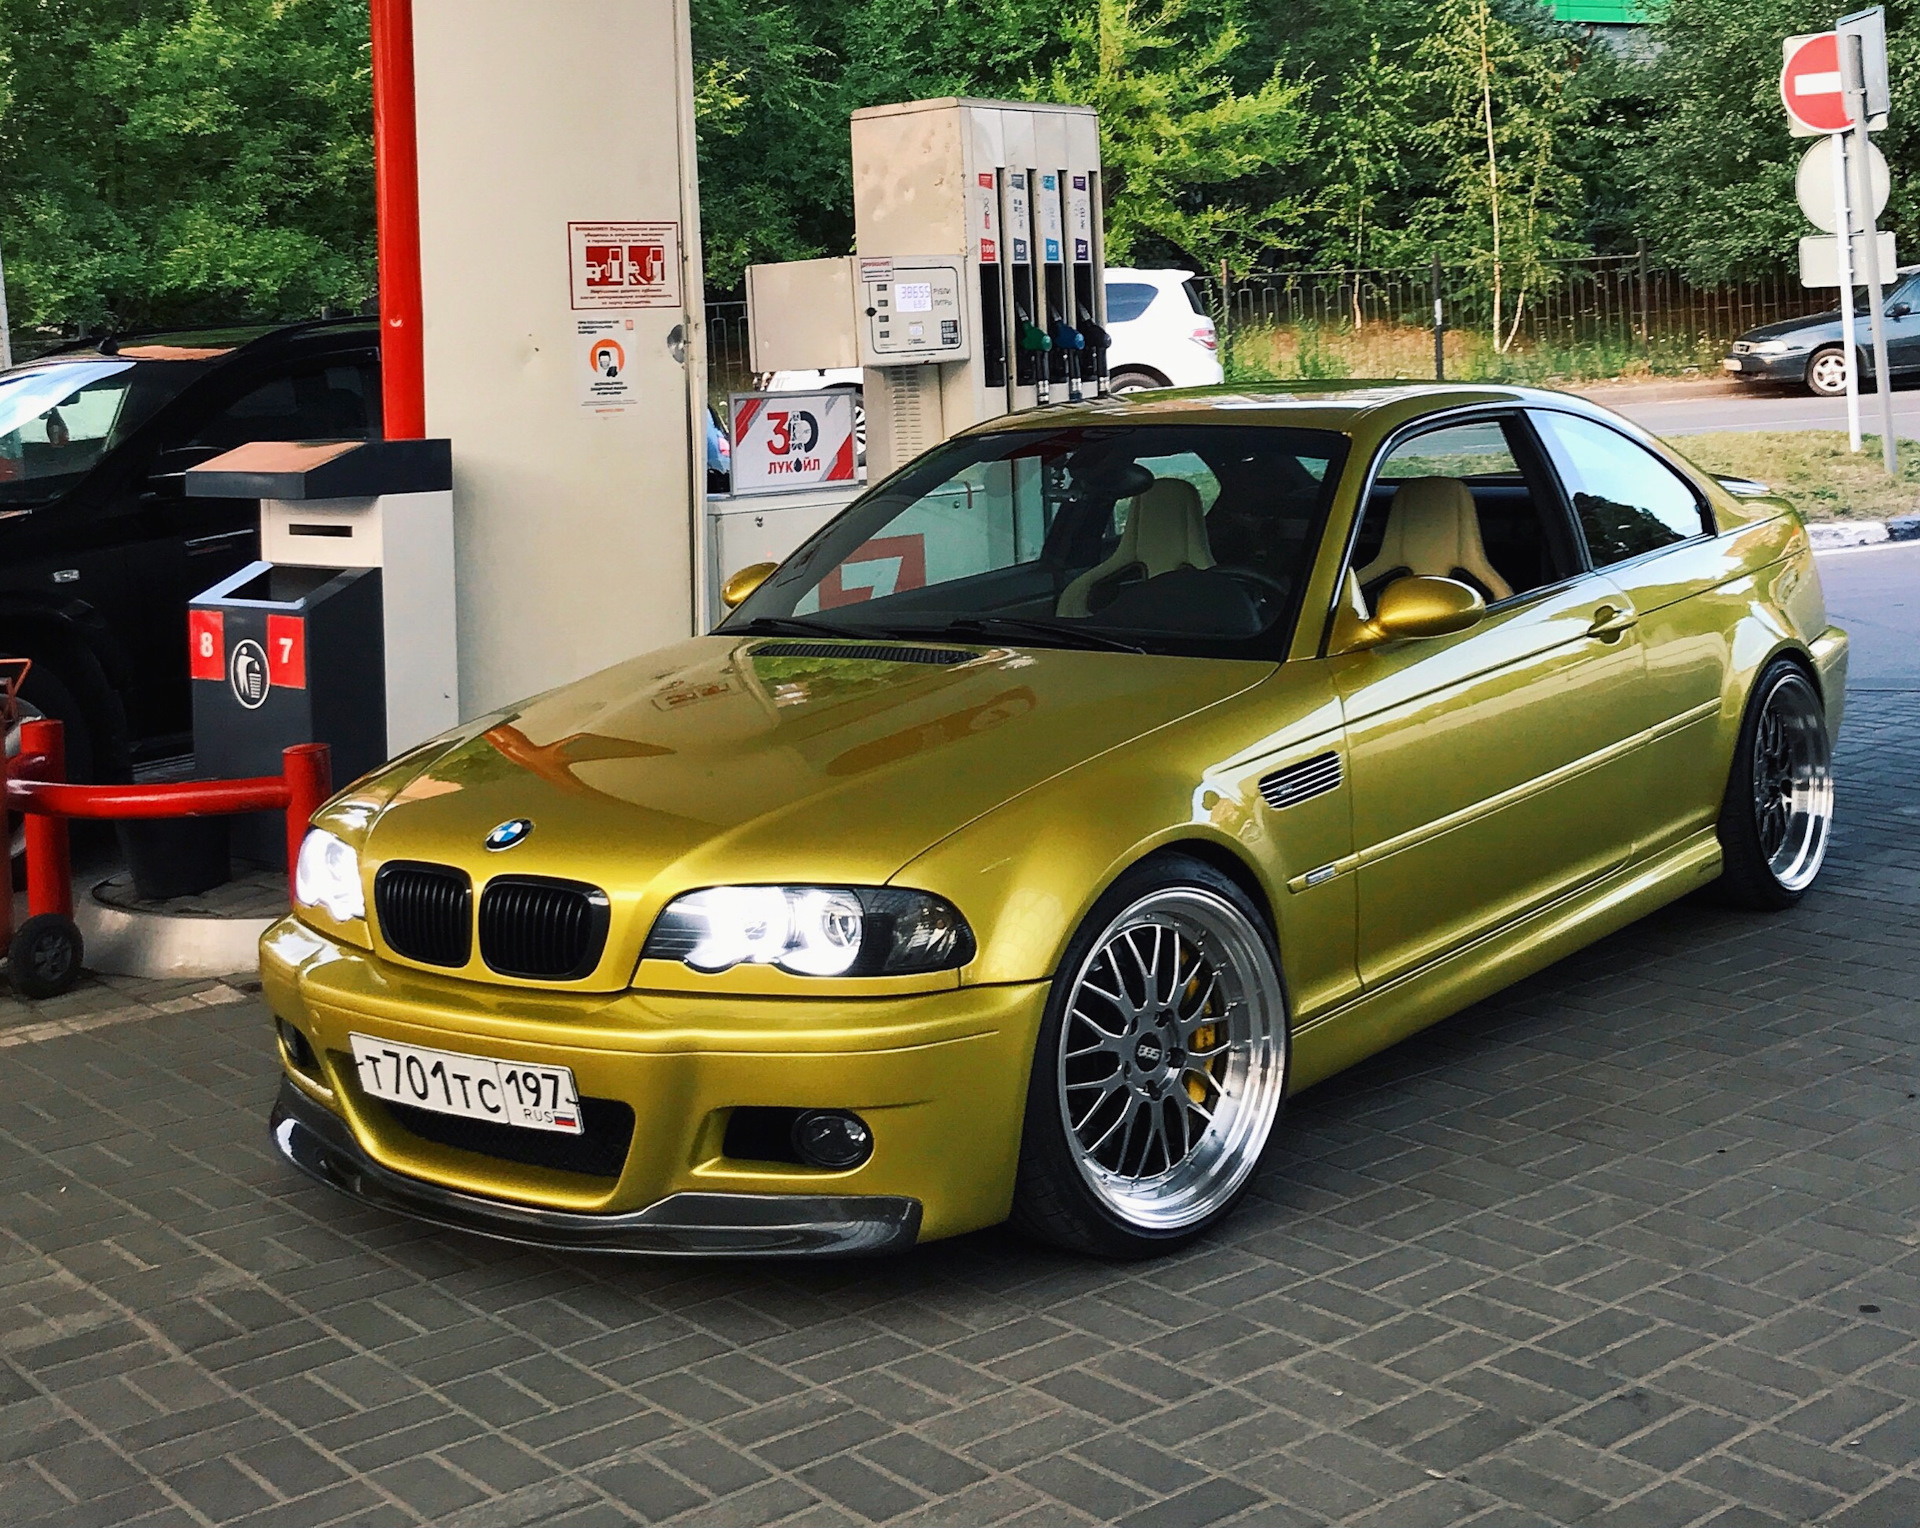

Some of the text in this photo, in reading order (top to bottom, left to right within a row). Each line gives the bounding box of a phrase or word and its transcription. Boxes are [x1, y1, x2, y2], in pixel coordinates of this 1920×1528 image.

[981, 243, 995, 254] 100
[1047, 244, 1057, 254] 92
[200, 631, 214, 658] 8
[279, 637, 293, 664] 7
[505, 1070, 559, 1110] 197
[524, 1108, 554, 1123] RUS
